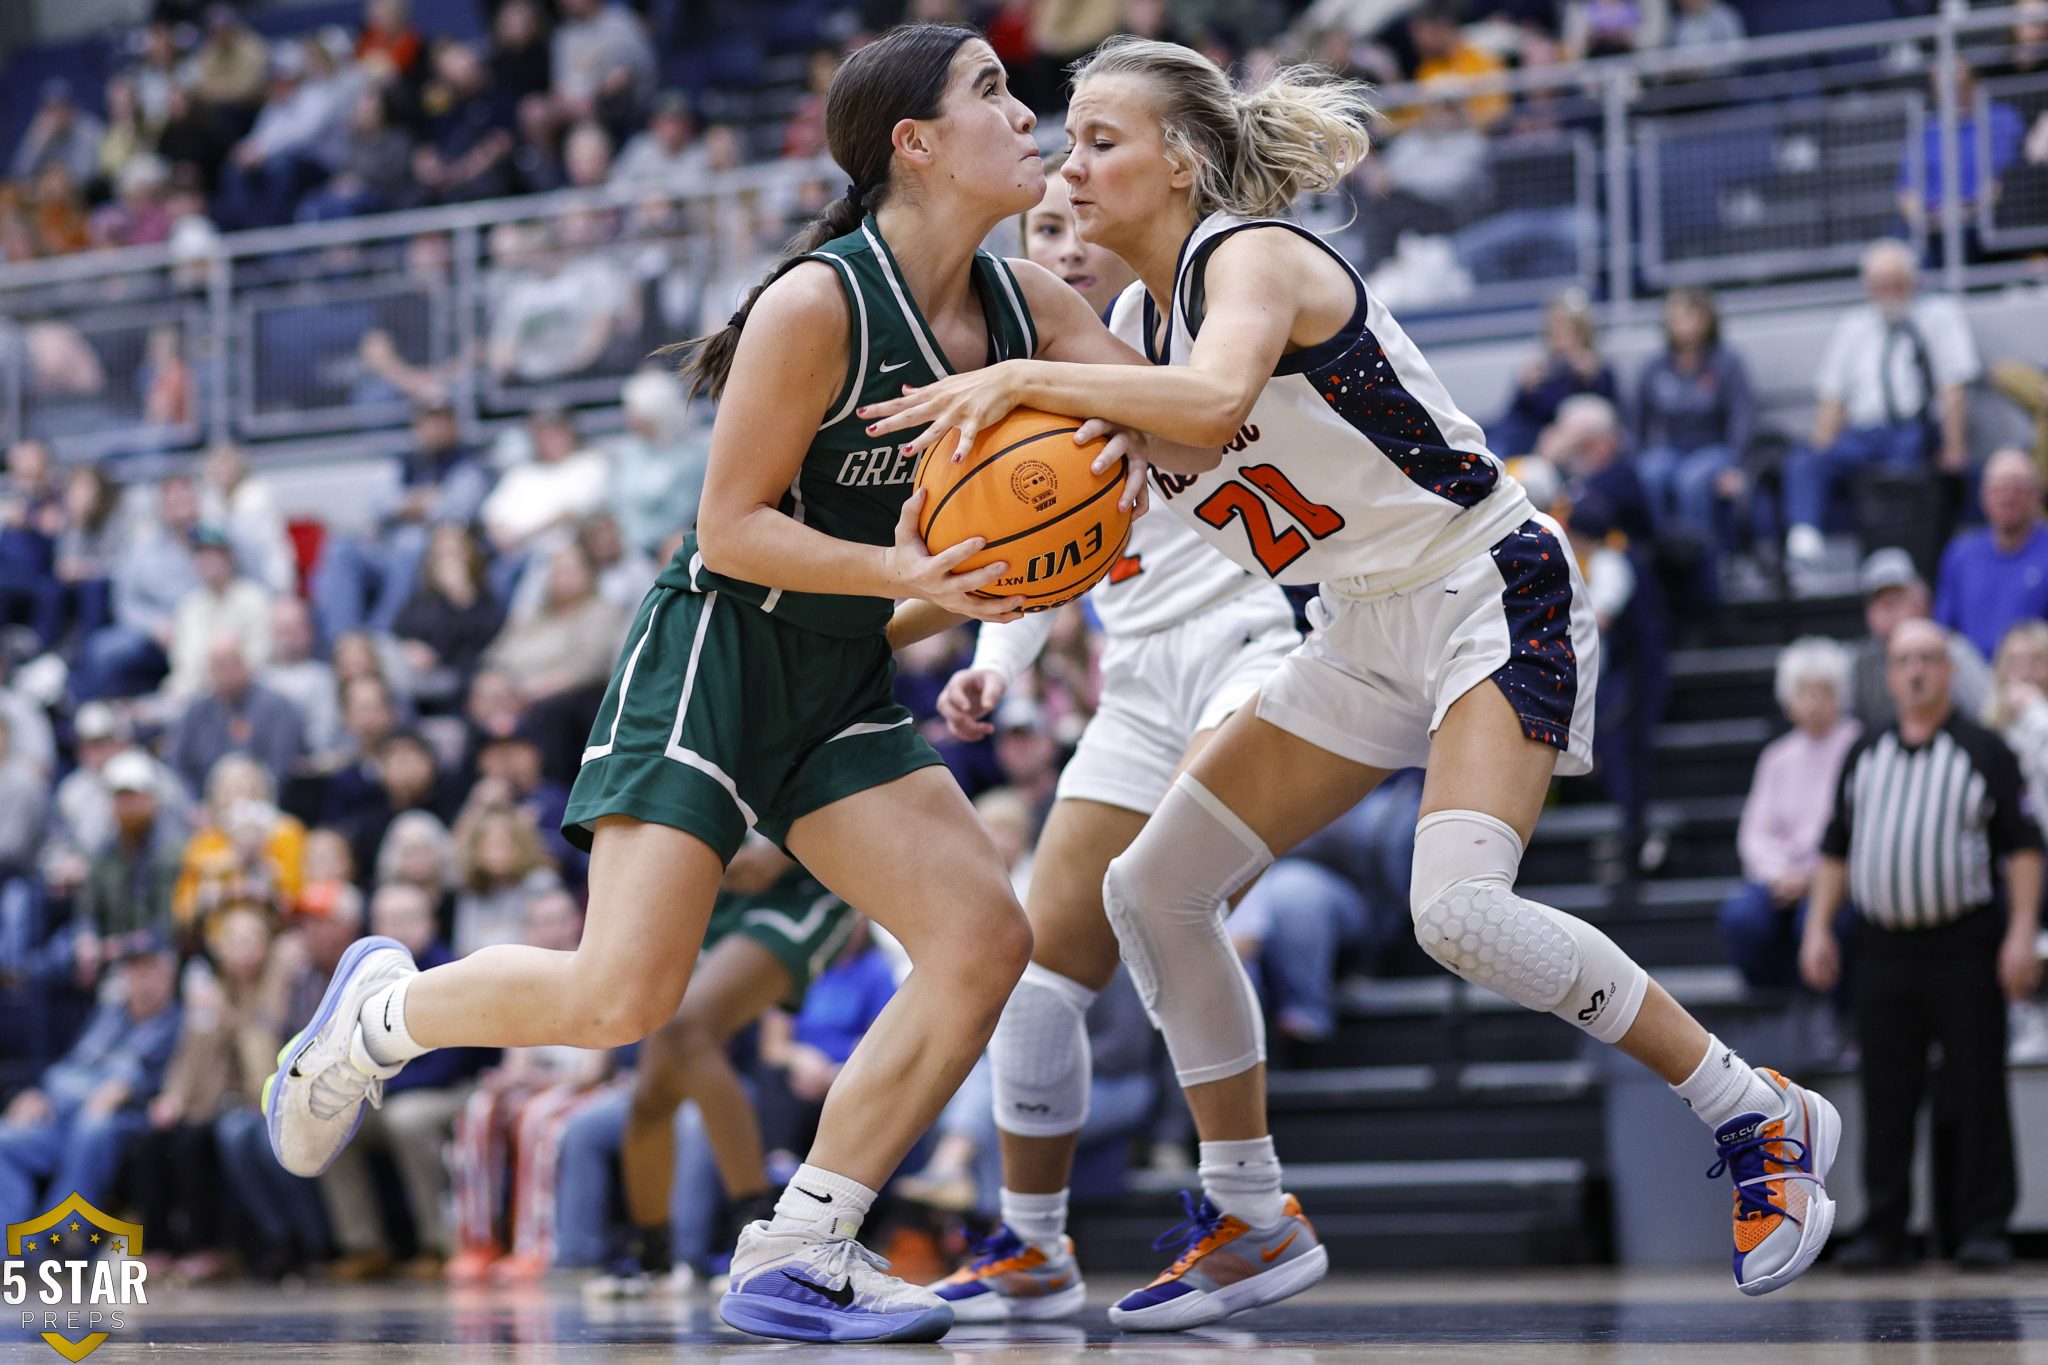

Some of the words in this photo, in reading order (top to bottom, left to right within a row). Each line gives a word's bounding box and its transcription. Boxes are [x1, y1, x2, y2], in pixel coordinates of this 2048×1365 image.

[1026, 521, 1103, 583] EVO
[1194, 463, 1346, 579] 21
[994, 576, 1024, 587] NXT
